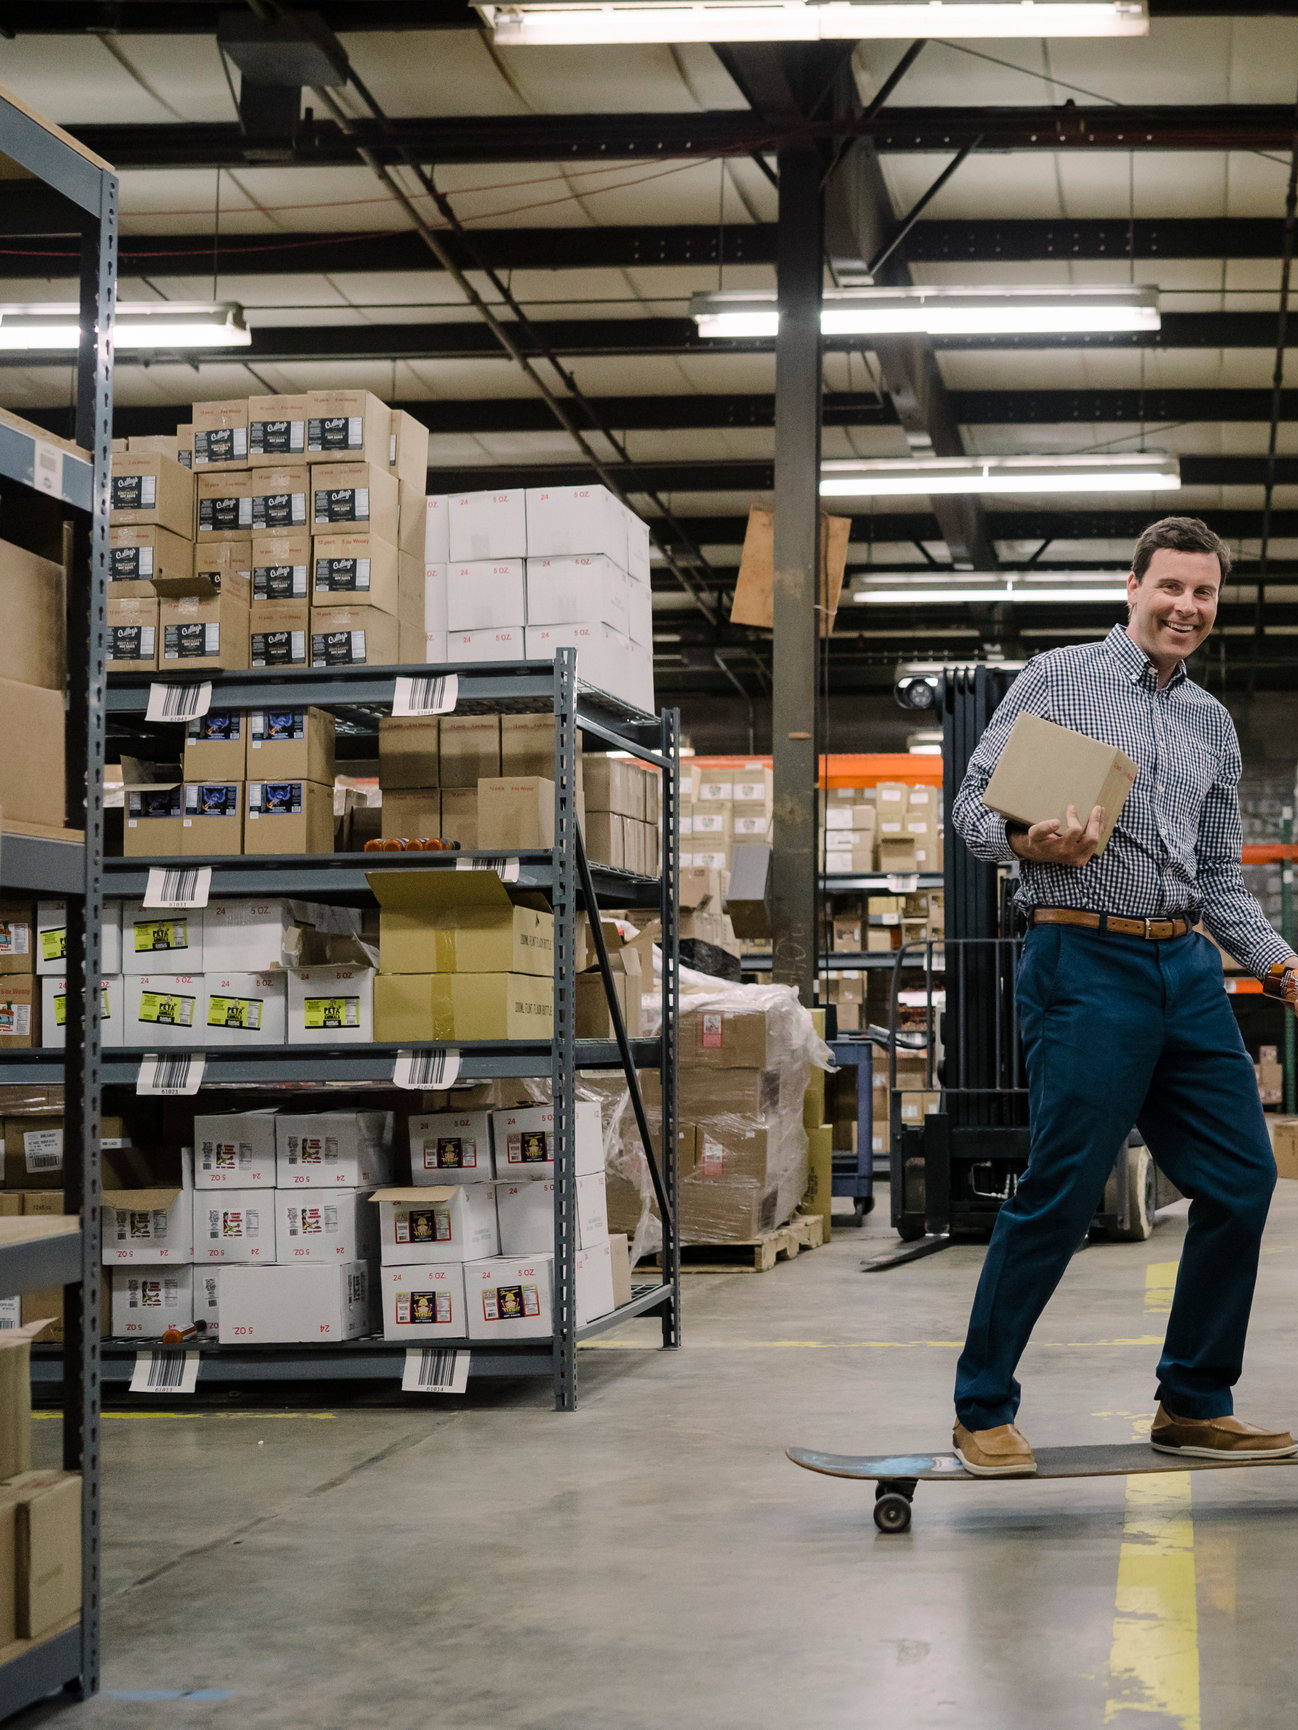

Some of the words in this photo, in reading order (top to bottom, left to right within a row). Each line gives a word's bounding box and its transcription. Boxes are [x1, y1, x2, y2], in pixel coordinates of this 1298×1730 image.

[461, 569, 469, 577] 24
[463, 636, 471, 644] 24
[216, 907, 226, 915] 24
[301, 972, 310, 981] 24
[140, 977, 150, 985] 24
[221, 980, 230, 988] 24
[507, 1117, 516, 1126] 24
[222, 1174, 227, 1182] 5
[252, 1172, 261, 1181] 24
[336, 1174, 345, 1182] 24
[509, 1187, 518, 1195] 24
[160, 1249, 169, 1257] 24
[250, 1248, 259, 1256] 24
[393, 1274, 402, 1282] 24
[482, 1271, 491, 1279] 24
[138, 1323, 142, 1331] 5
[248, 1326, 254, 1335] 5
[320, 1324, 330, 1333] 24
